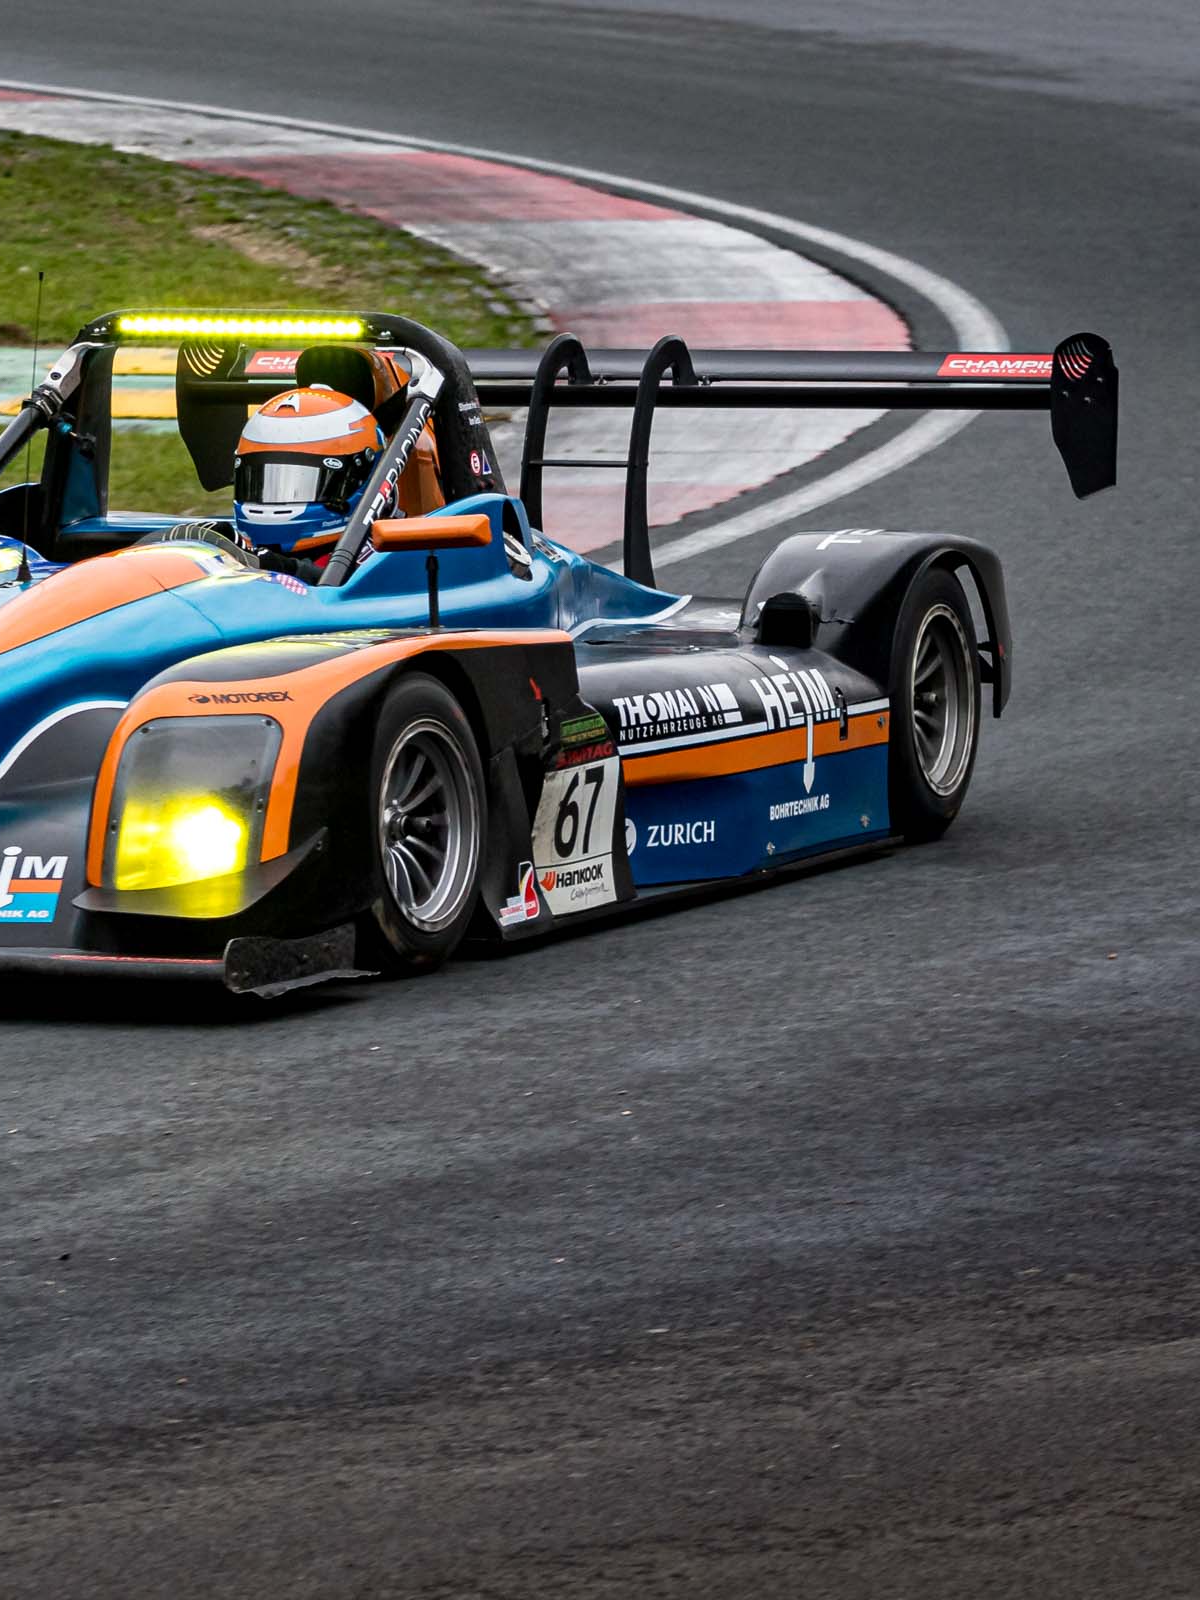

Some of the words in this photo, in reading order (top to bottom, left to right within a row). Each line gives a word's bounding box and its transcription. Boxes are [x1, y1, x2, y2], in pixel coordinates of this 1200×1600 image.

[948, 360, 1053, 369] CHAMPI
[211, 691, 294, 704] MOTOREX
[620, 716, 707, 741] NUTZFAHRZEUGE
[712, 714, 723, 726] AG
[554, 765, 605, 858] 67
[770, 796, 818, 820] BOHRTECHNIK
[820, 794, 830, 810] AG
[646, 820, 716, 847] ZURICH
[26, 910, 49, 918] AG
